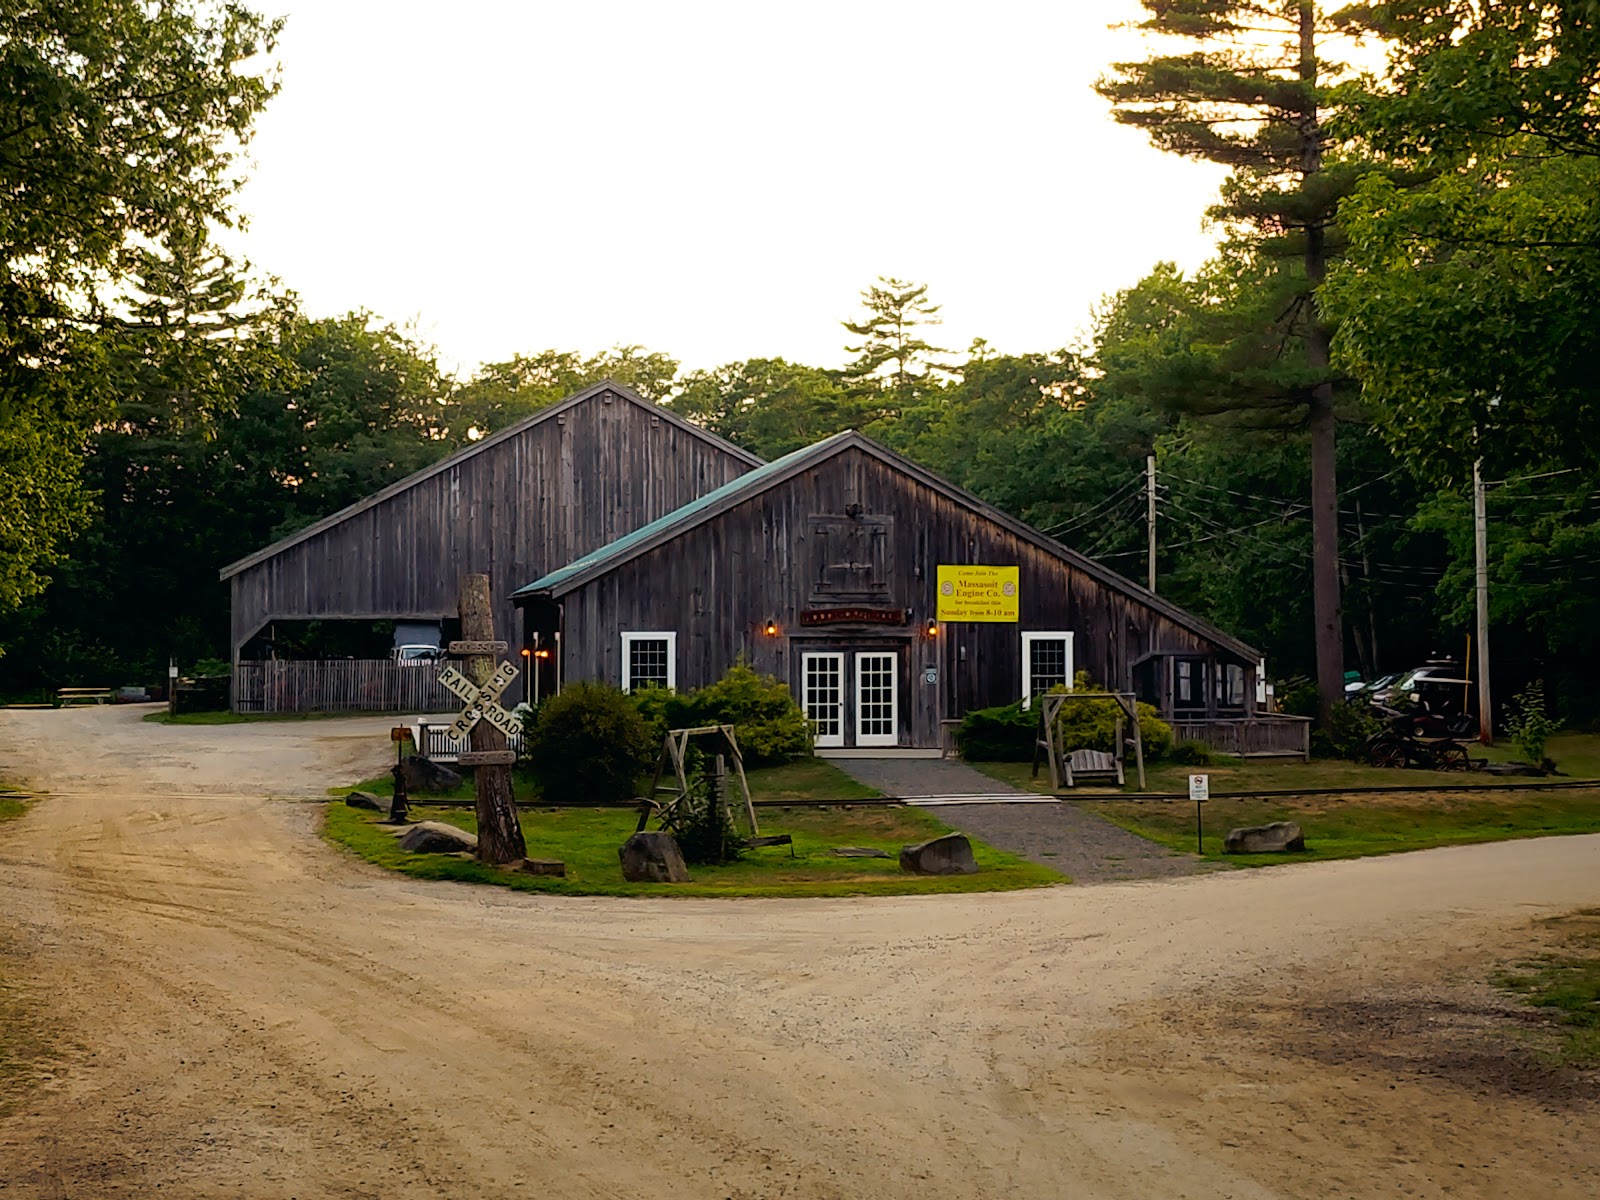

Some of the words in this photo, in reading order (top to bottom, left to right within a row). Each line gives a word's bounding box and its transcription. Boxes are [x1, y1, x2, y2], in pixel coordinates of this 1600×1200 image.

[958, 580, 998, 588] Massasoit
[956, 589, 984, 598] Engine
[986, 589, 1000, 597] Co.
[940, 609, 967, 617] Sunday
